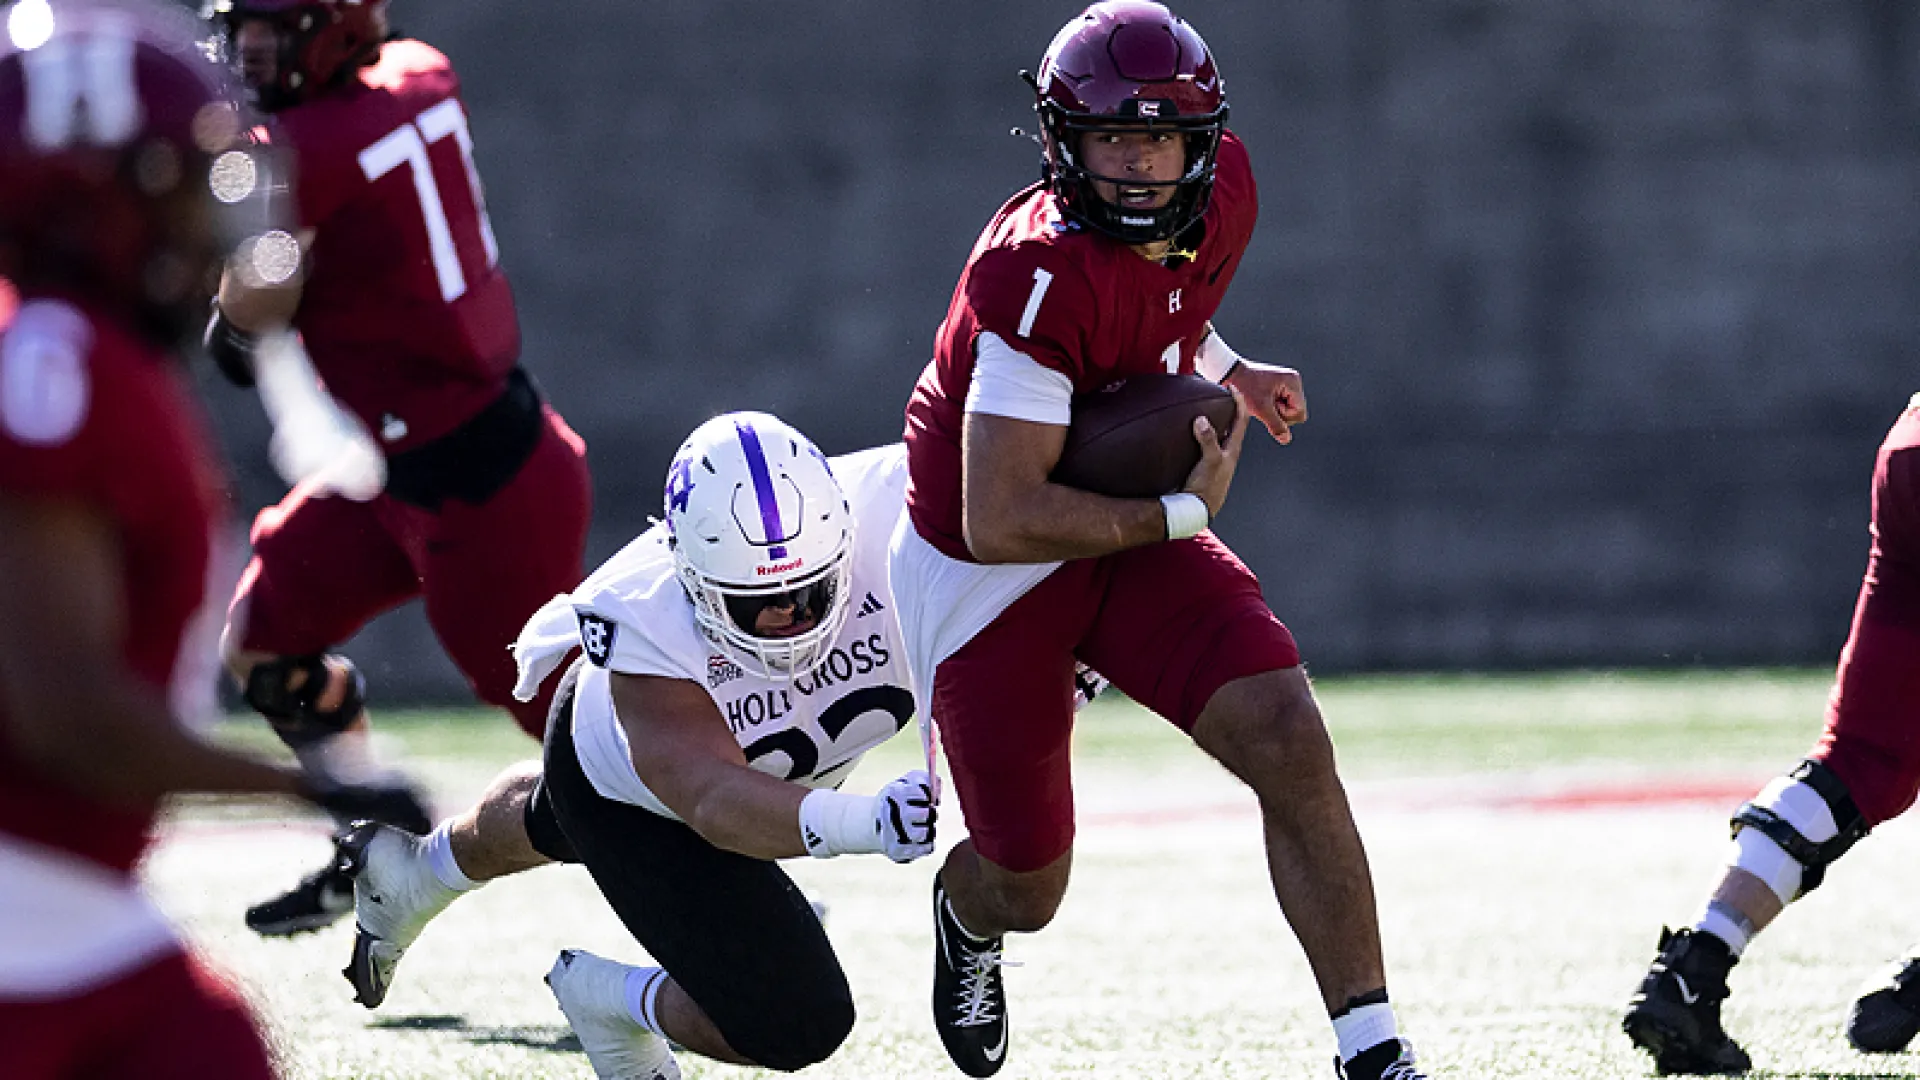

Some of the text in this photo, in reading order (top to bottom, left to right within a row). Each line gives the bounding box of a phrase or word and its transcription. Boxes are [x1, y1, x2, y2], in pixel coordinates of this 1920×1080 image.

[357, 98, 498, 303] 77
[1018, 267, 1054, 337] 1
[1169, 288, 1182, 314] H
